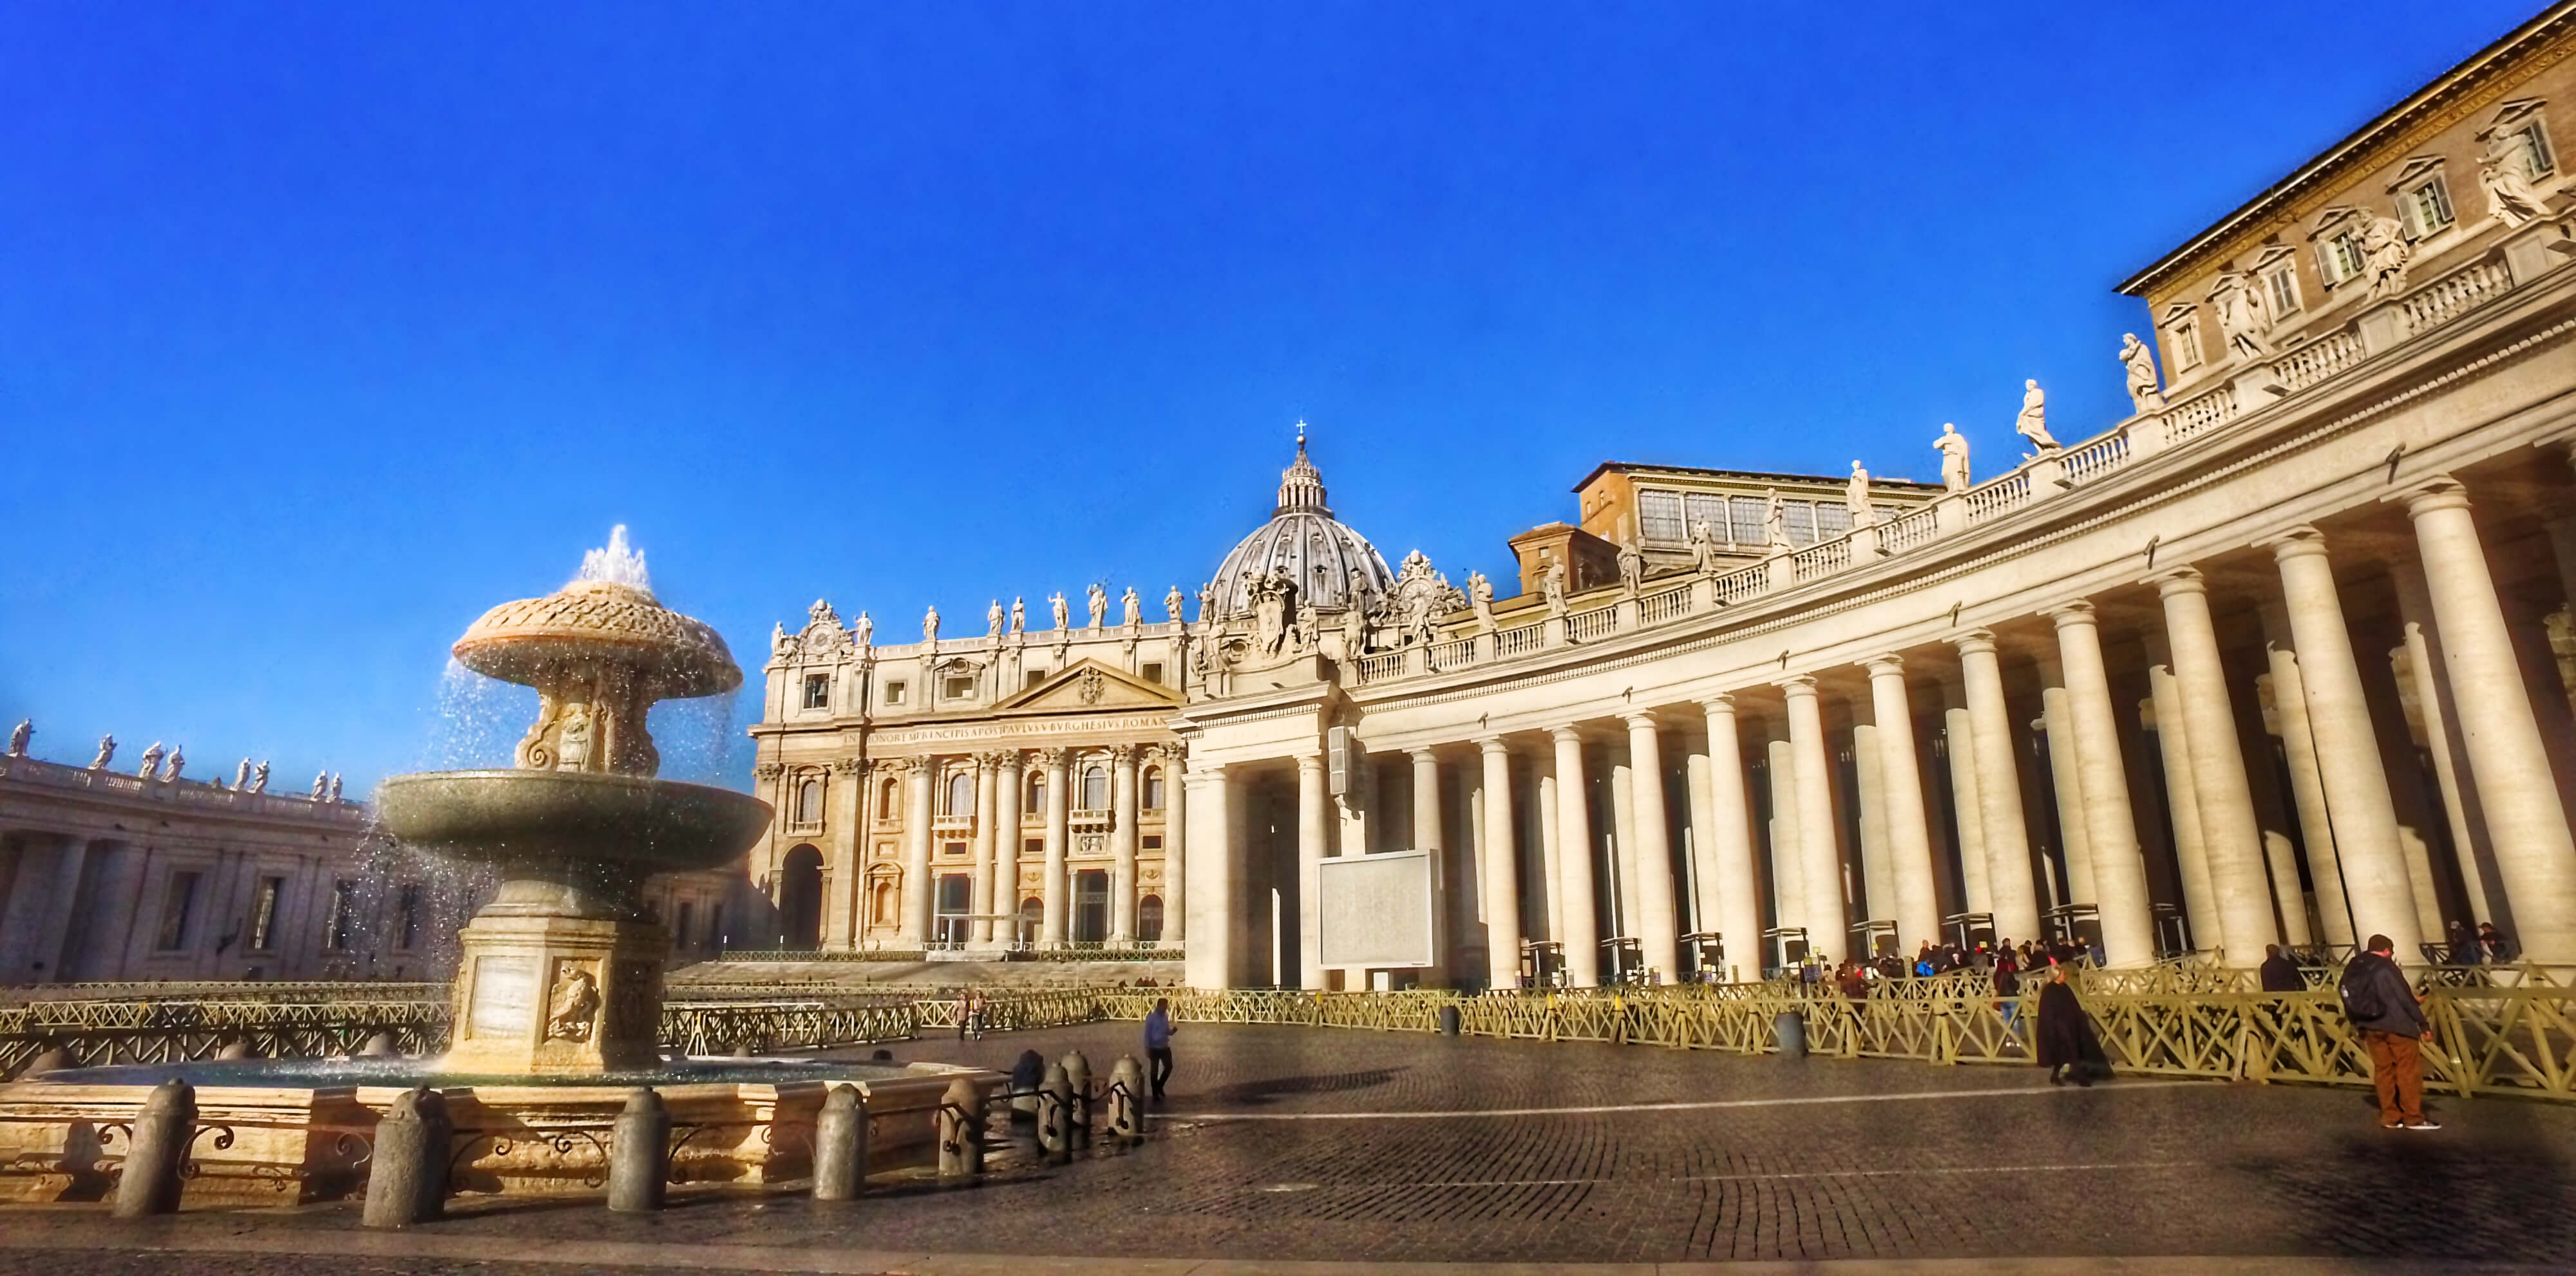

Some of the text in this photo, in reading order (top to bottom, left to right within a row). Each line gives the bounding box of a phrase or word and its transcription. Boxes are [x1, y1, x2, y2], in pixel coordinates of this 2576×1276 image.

[844, 734, 856, 743] IN
[916, 729, 969, 740] PRINCIPIS
[1002, 724, 1039, 734] PAVLVS
[1050, 719, 1120, 731] BVRGHESIVS
